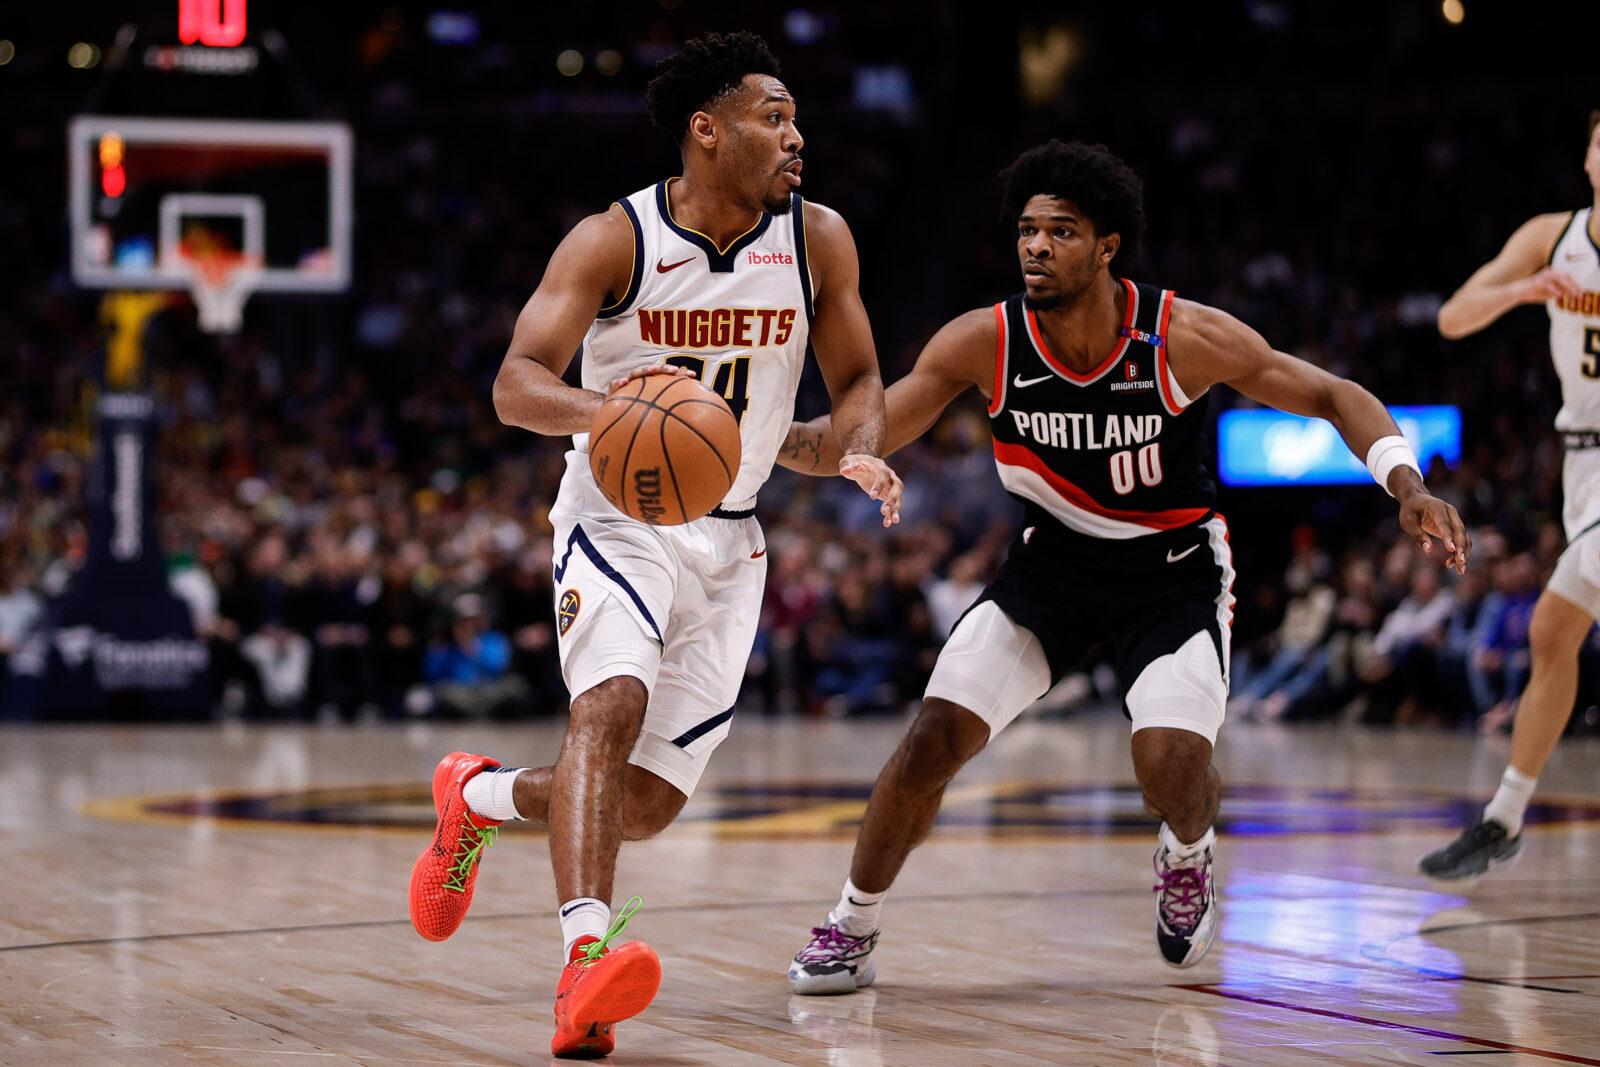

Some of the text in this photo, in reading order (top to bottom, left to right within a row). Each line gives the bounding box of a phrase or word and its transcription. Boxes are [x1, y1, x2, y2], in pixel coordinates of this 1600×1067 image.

[748, 252, 793, 265] ibotta
[637, 308, 797, 348] NUGGETS
[1138, 331, 1151, 343] 32
[1129, 363, 1137, 378] B
[1110, 380, 1154, 390] BRIGHTSIDE
[1008, 409, 1163, 450] PORTLAND
[1109, 442, 1164, 496] 00
